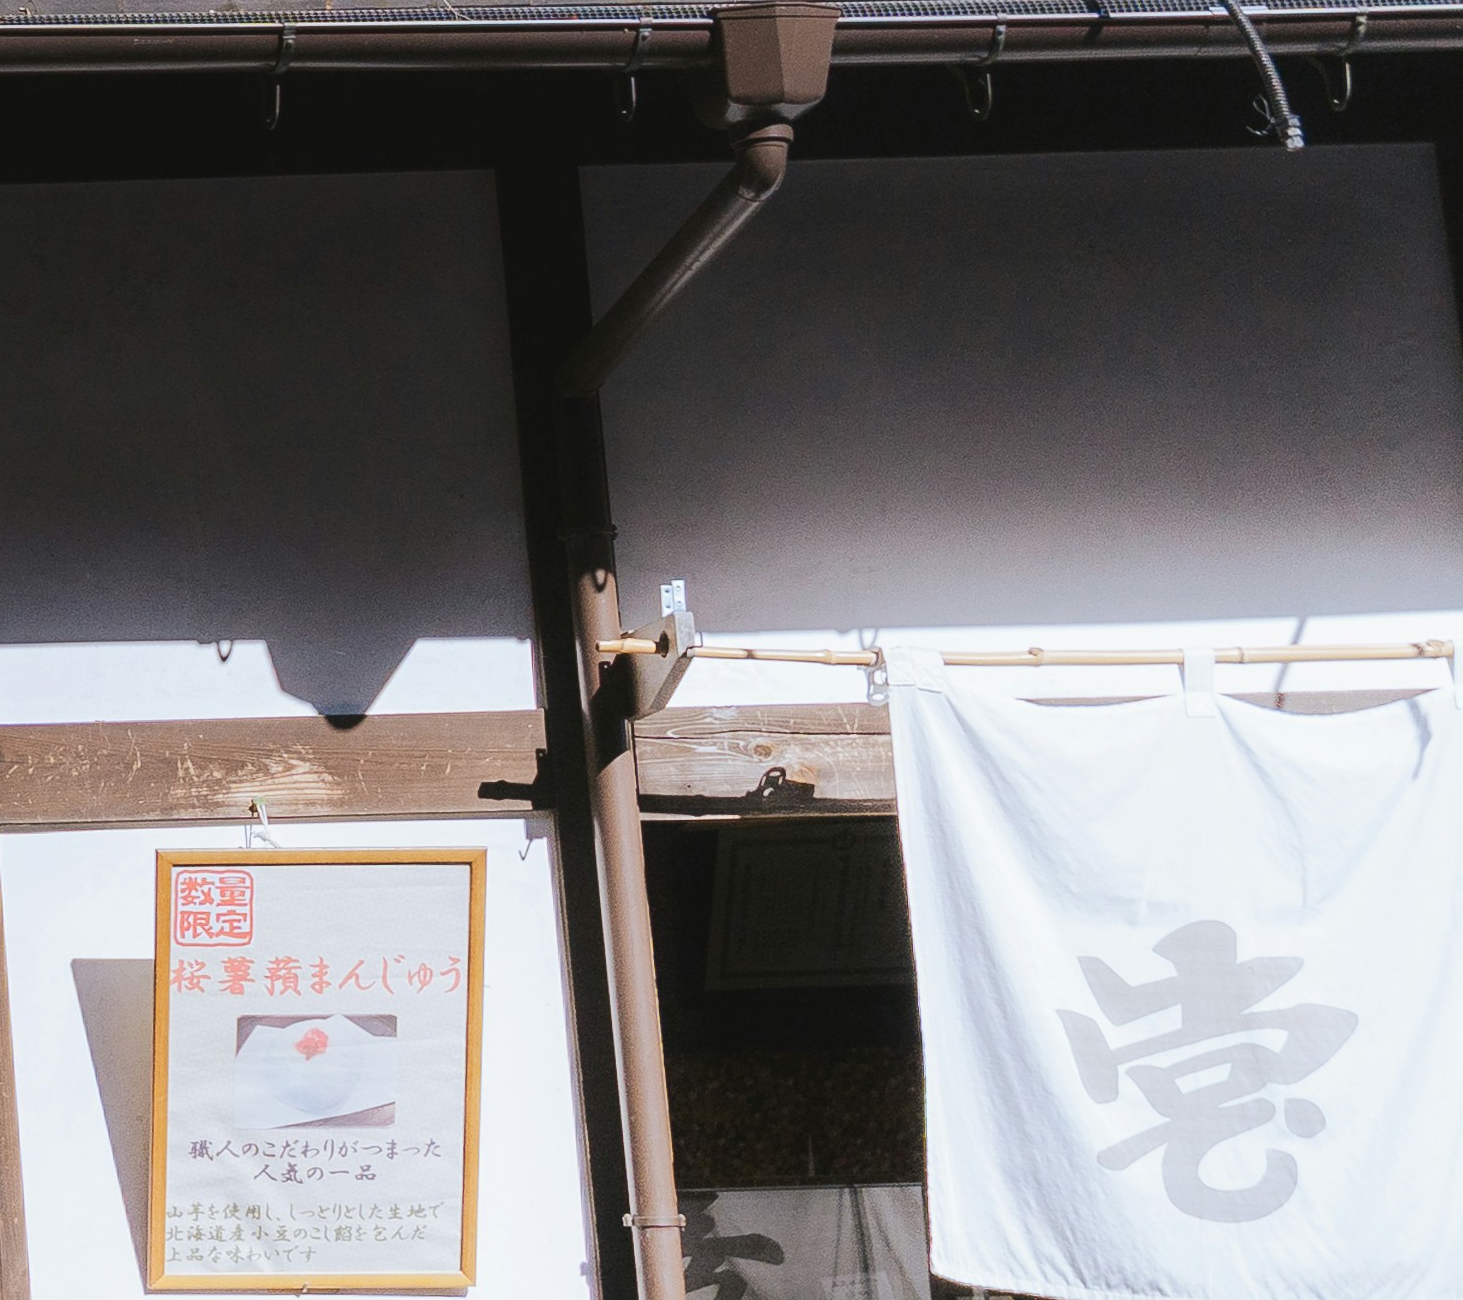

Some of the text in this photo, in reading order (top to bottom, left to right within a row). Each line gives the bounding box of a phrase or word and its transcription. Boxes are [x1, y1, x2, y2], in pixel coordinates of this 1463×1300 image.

[1055, 919, 1360, 1223] 堂
[188, 1139, 442, 1160] 職人のこだわりがつまった
[253, 1162, 378, 1185] 人気の一品
[165, 1245, 317, 1264] 上品な味わいです
